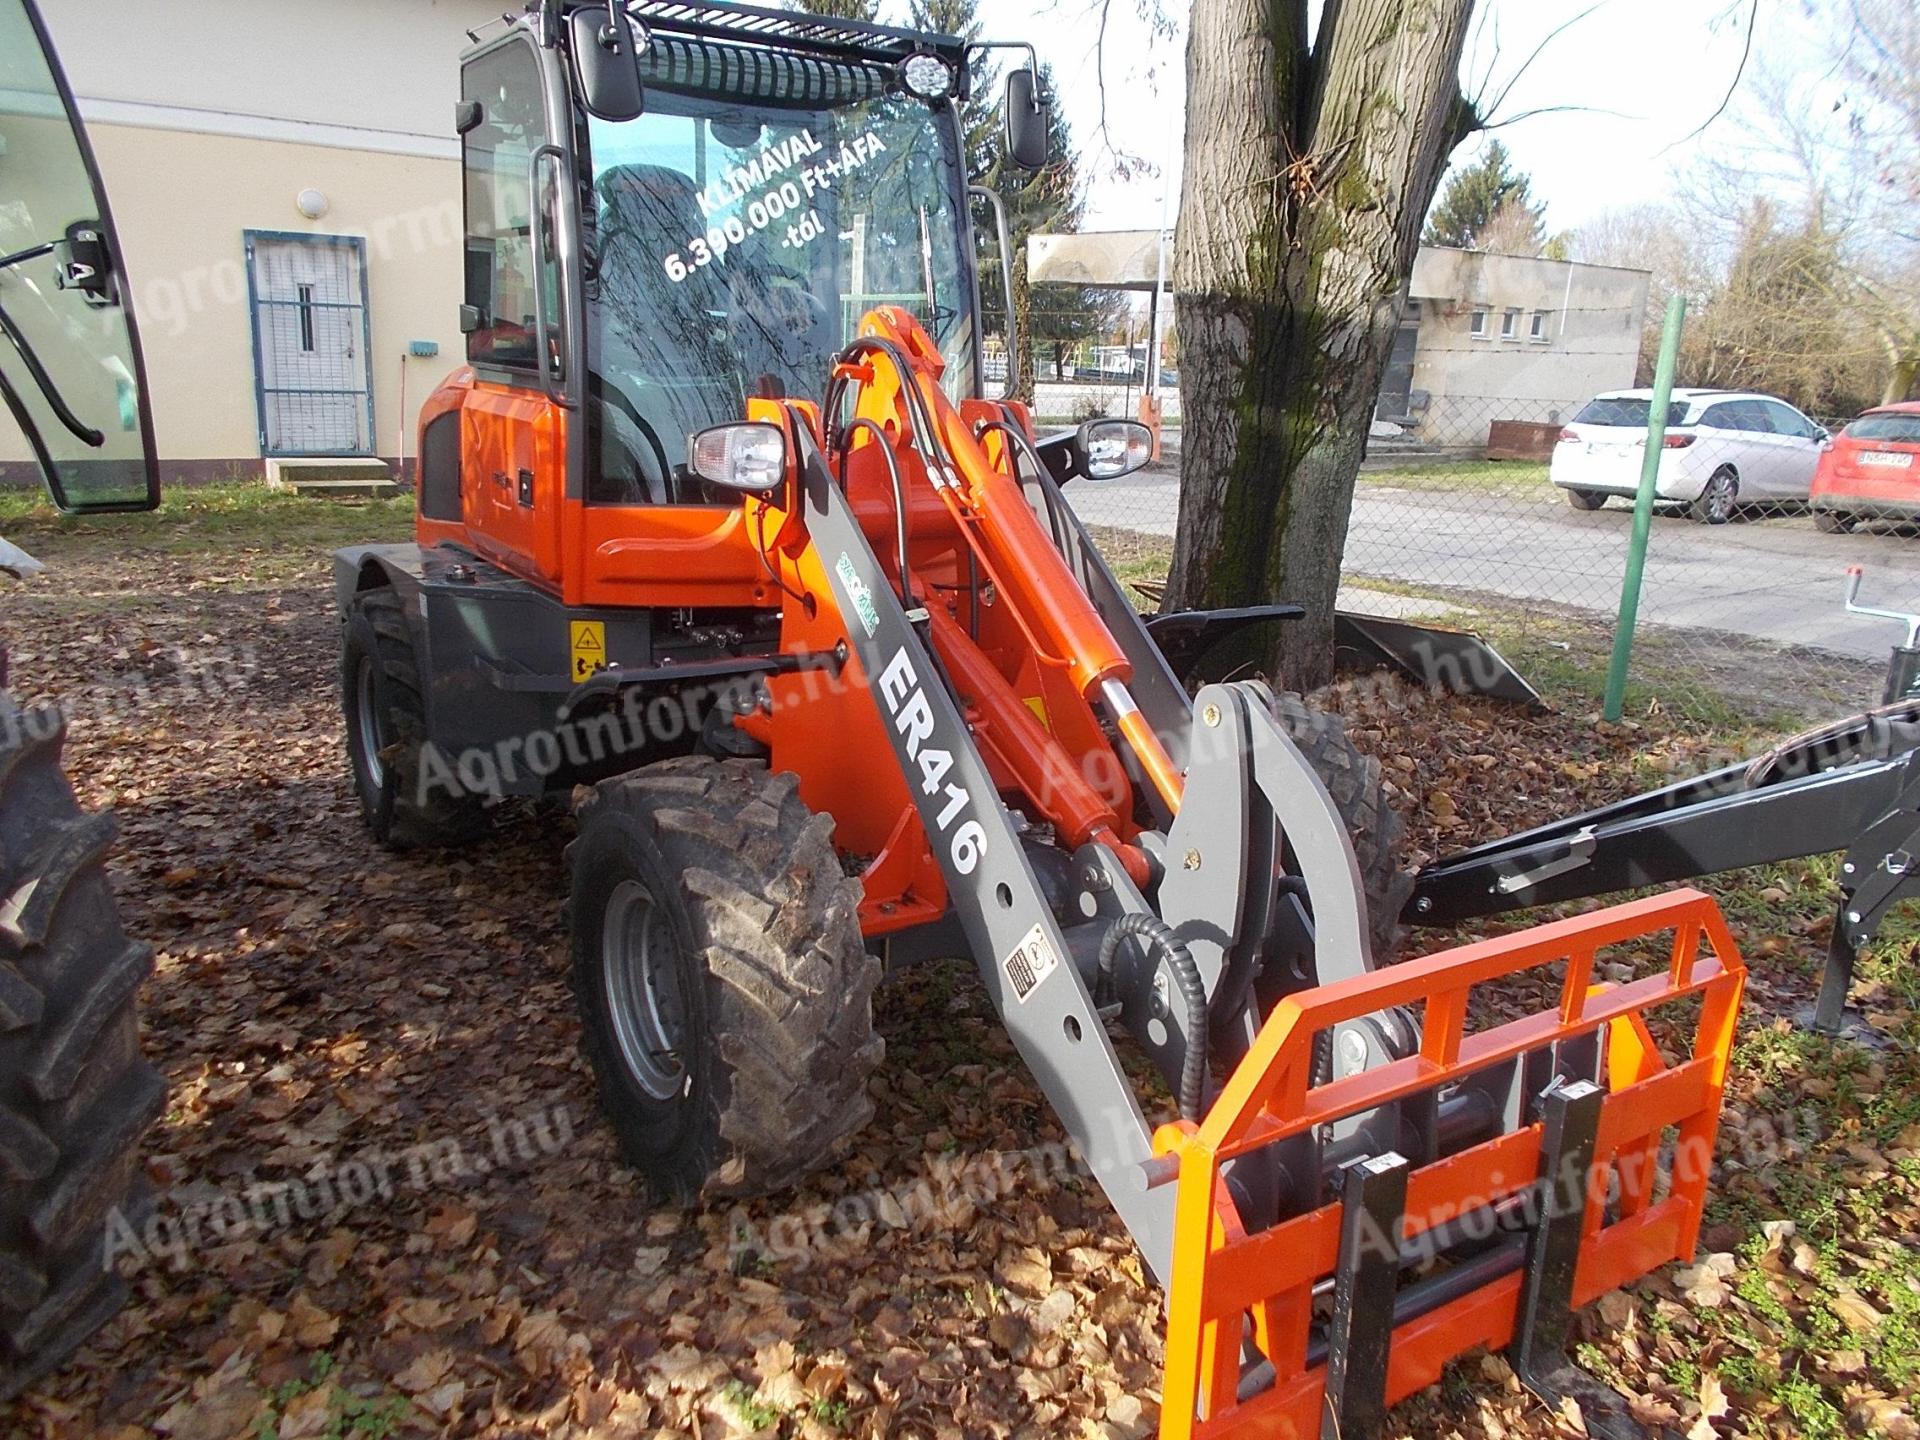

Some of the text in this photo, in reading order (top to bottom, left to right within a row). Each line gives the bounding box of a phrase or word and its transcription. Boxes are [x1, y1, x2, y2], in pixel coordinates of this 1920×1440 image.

[664, 182, 801, 282] 6.390.000
[800, 131, 887, 198] Ft+ÁFA
[695, 128, 823, 217] KLÍMÁVAL
[781, 209, 826, 249] -tól
[878, 645, 987, 874] ER416
